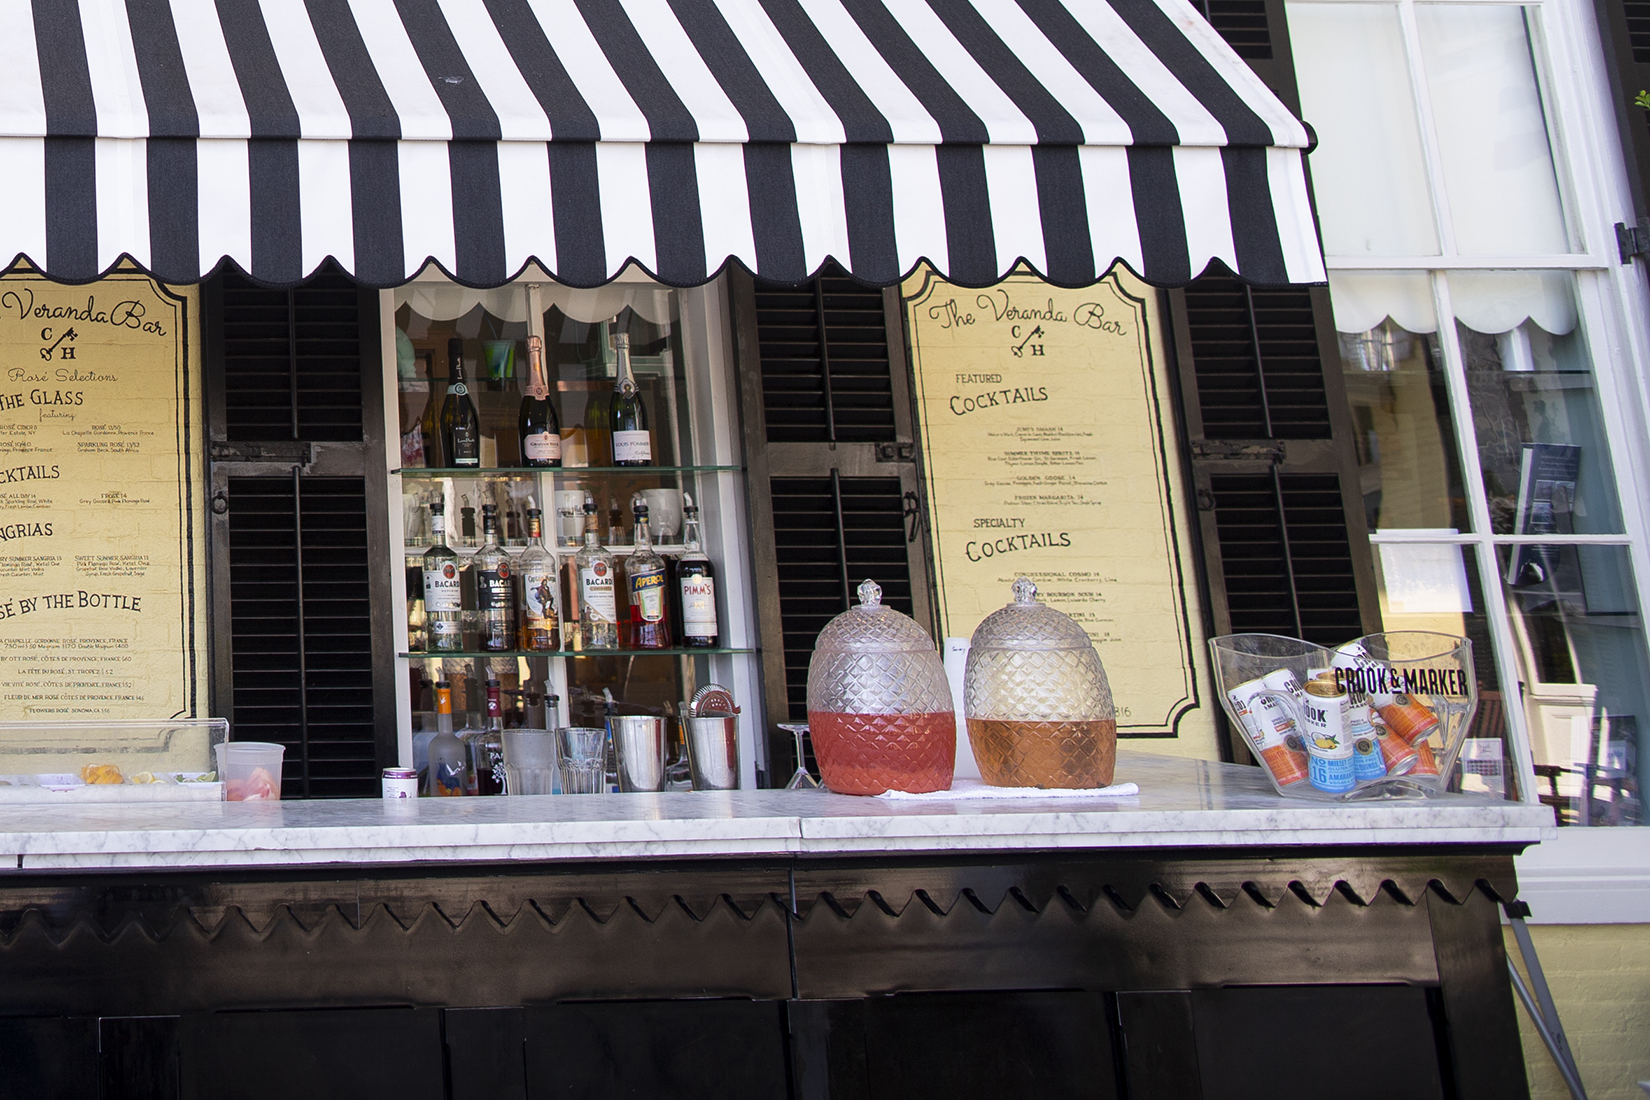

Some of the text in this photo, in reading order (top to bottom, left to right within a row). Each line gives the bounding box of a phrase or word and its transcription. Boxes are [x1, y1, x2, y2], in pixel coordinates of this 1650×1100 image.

[2, 288, 109, 324] Veranda
[110, 300, 167, 337] Bar
[929, 289, 1127, 336] The Veranda Bar
[41, 327, 53, 341] C
[1011, 325, 1021, 339] C
[60, 347, 76, 360] H
[1030, 345, 1045, 356] H
[8, 368, 119, 383] Rosé Selections
[955, 374, 1003, 384] FEATURED
[30, 389, 84, 407] GLASS
[950, 387, 1049, 416] COCKTAILS
[39, 408, 77, 422] featuring
[973, 518, 1026, 528] SPECIALTY
[965, 532, 1071, 563] COCKTAILS
[434, 580, 460, 588] BACARD
[586, 578, 612, 586] BACARD
[635, 574, 664, 590] APEROL
[683, 583, 712, 595] PIMM'S
[18, 597, 38, 615] BY
[42, 594, 74, 609] THE
[78, 590, 142, 613] BOTTLE
[1334, 667, 1468, 696] CROOK & MARKER
[1312, 766, 1327, 784] 16
